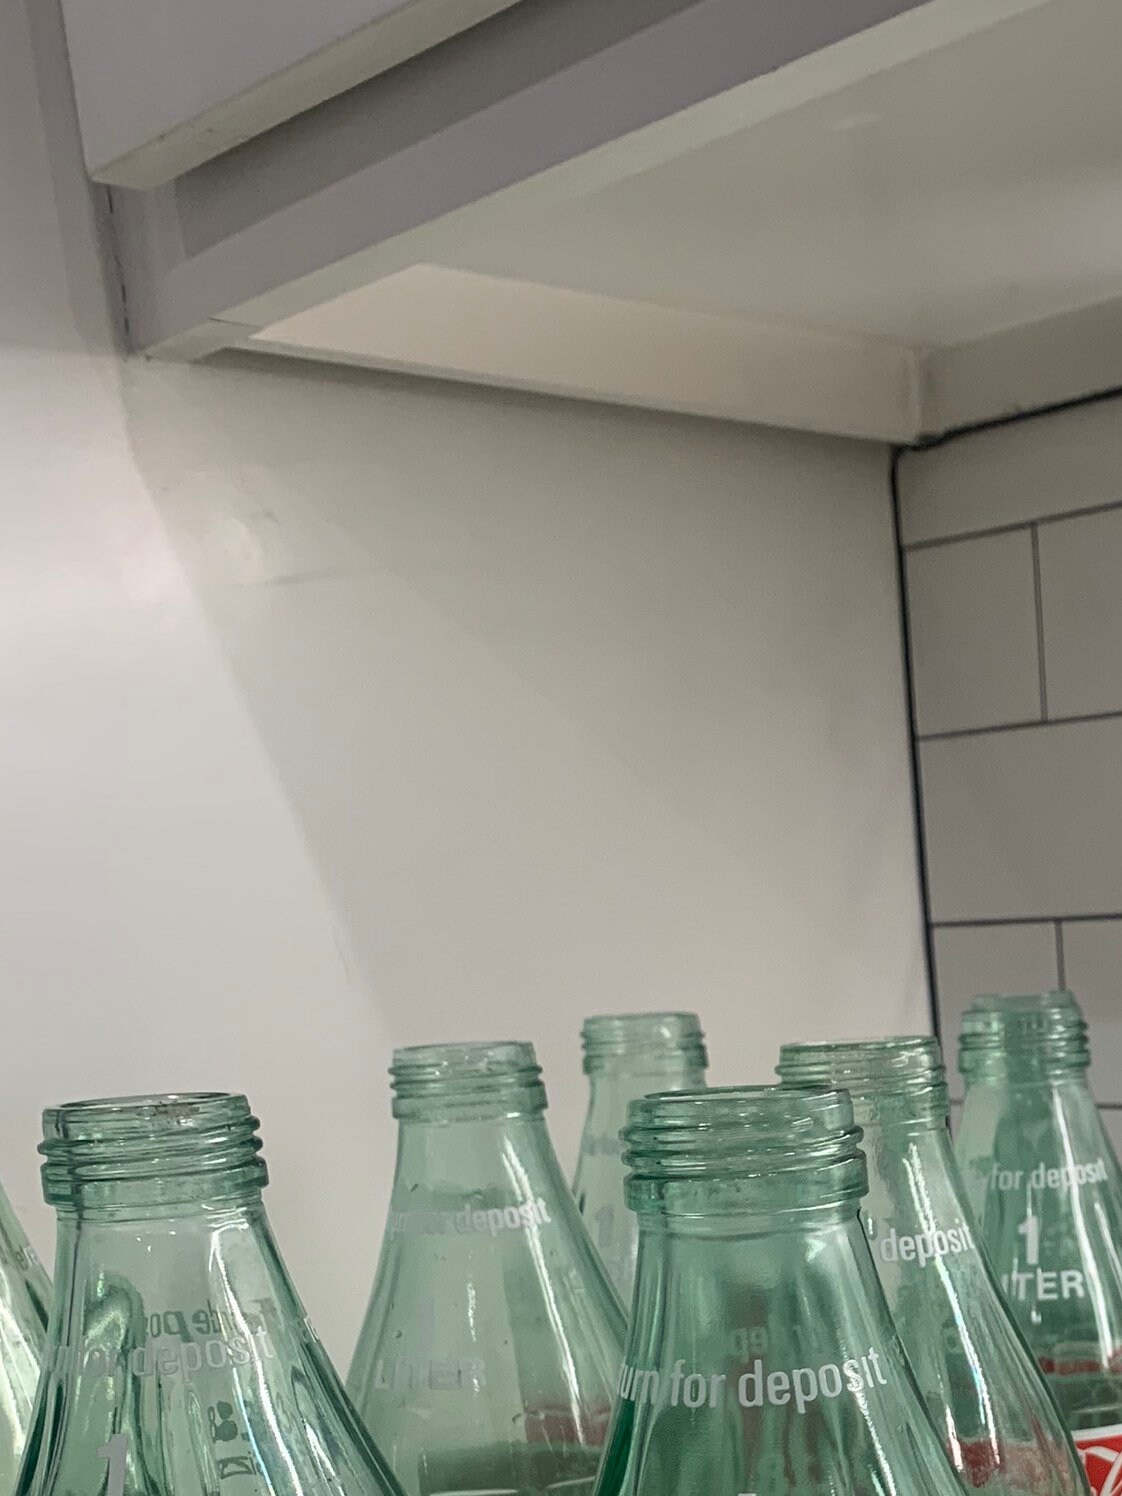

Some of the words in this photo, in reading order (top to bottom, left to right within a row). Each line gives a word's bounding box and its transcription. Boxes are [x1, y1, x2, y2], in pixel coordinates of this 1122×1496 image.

[1031, 1157, 1108, 1193] deposit
[456, 1197, 552, 1237] deposit
[1018, 1215, 1040, 1265] 1
[881, 1222, 975, 1268] deposit
[1001, 1269, 1086, 1301] ITER
[132, 1326, 275, 1384] deposit
[670, 1359, 727, 1409] for
[738, 1347, 888, 1415] deposit
